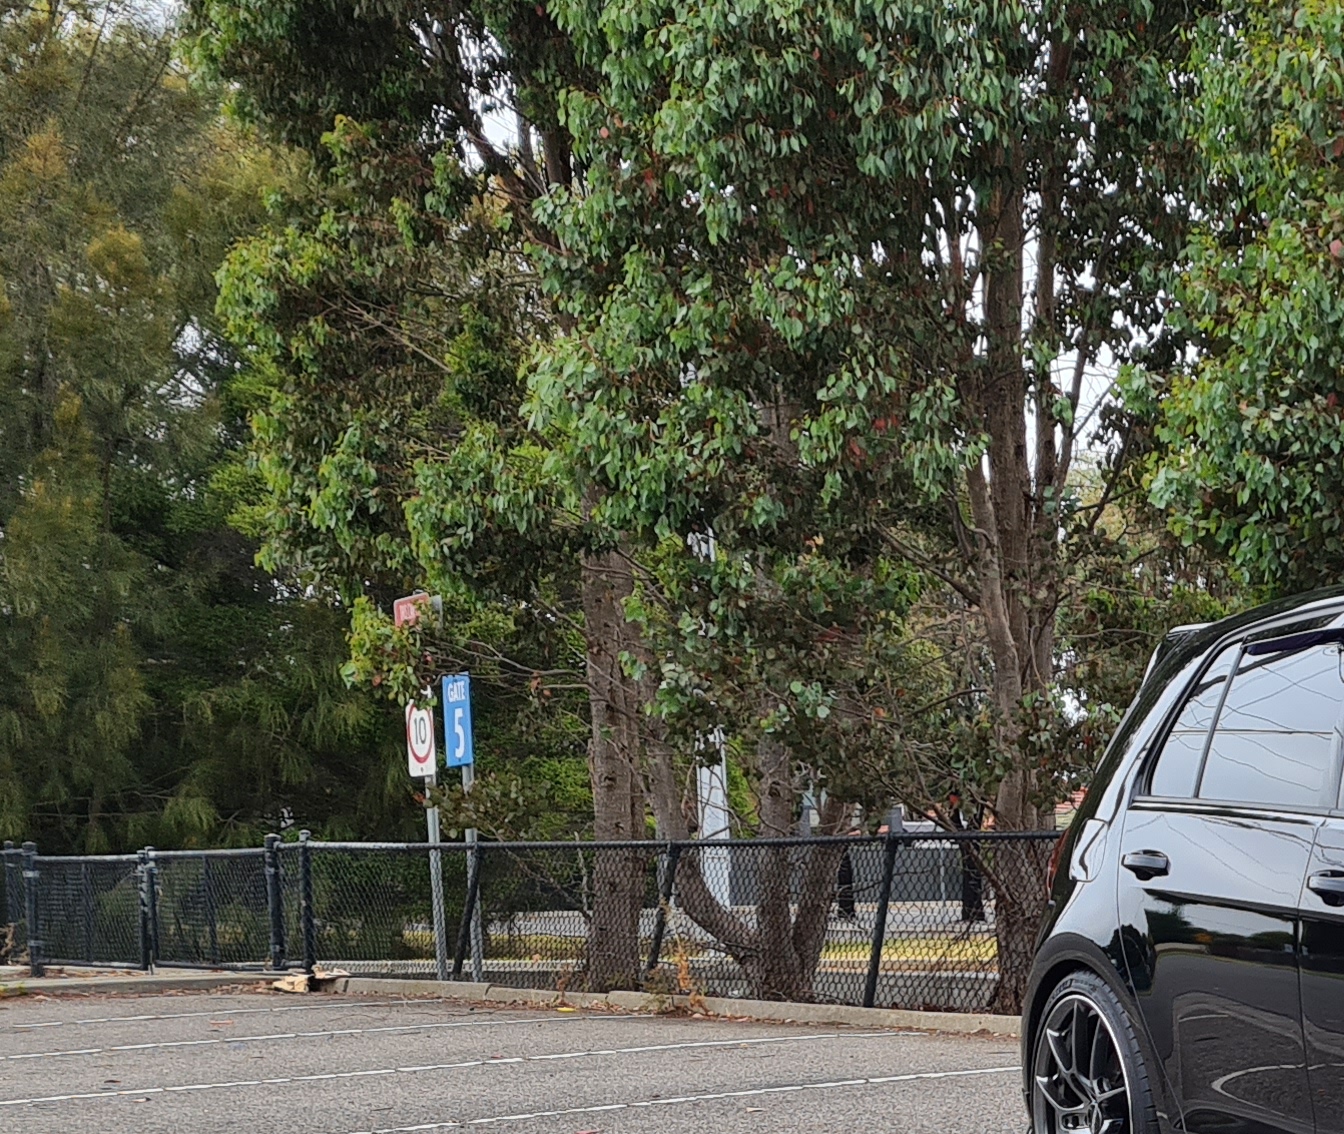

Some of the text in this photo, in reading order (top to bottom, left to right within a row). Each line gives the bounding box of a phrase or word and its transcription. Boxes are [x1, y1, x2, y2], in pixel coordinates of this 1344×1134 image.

[447, 681, 466, 703] GATE
[414, 717, 427, 745] 10
[454, 708, 465, 759] 5
